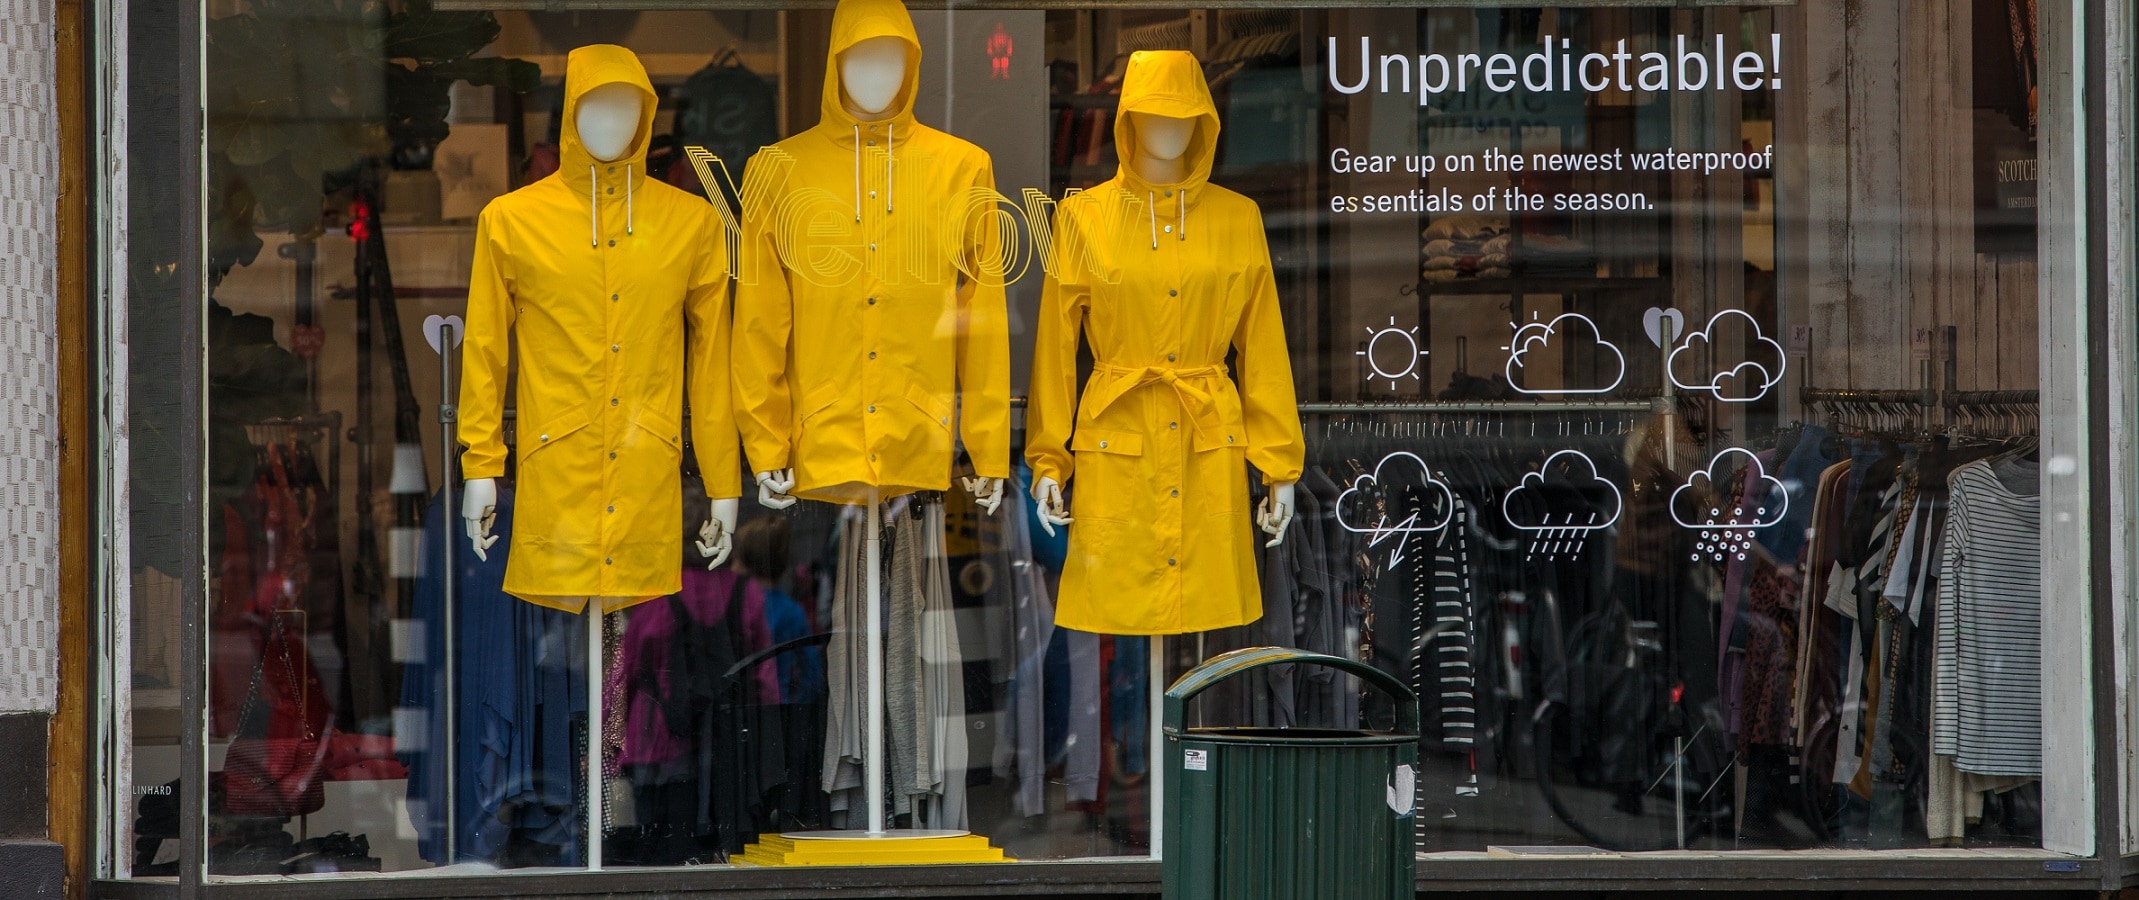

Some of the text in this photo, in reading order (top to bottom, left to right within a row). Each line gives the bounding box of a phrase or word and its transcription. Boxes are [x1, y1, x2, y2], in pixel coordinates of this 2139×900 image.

[1328, 33, 1783, 106] Unpredictable!
[1331, 144, 1773, 177] Gear up on the newest waterproof
[1998, 159, 2037, 182] SCOTCH
[1331, 186, 1653, 213] essentials of the season.
[683, 146, 1144, 287] Yellow
[132, 785, 172, 796] LINHARD
